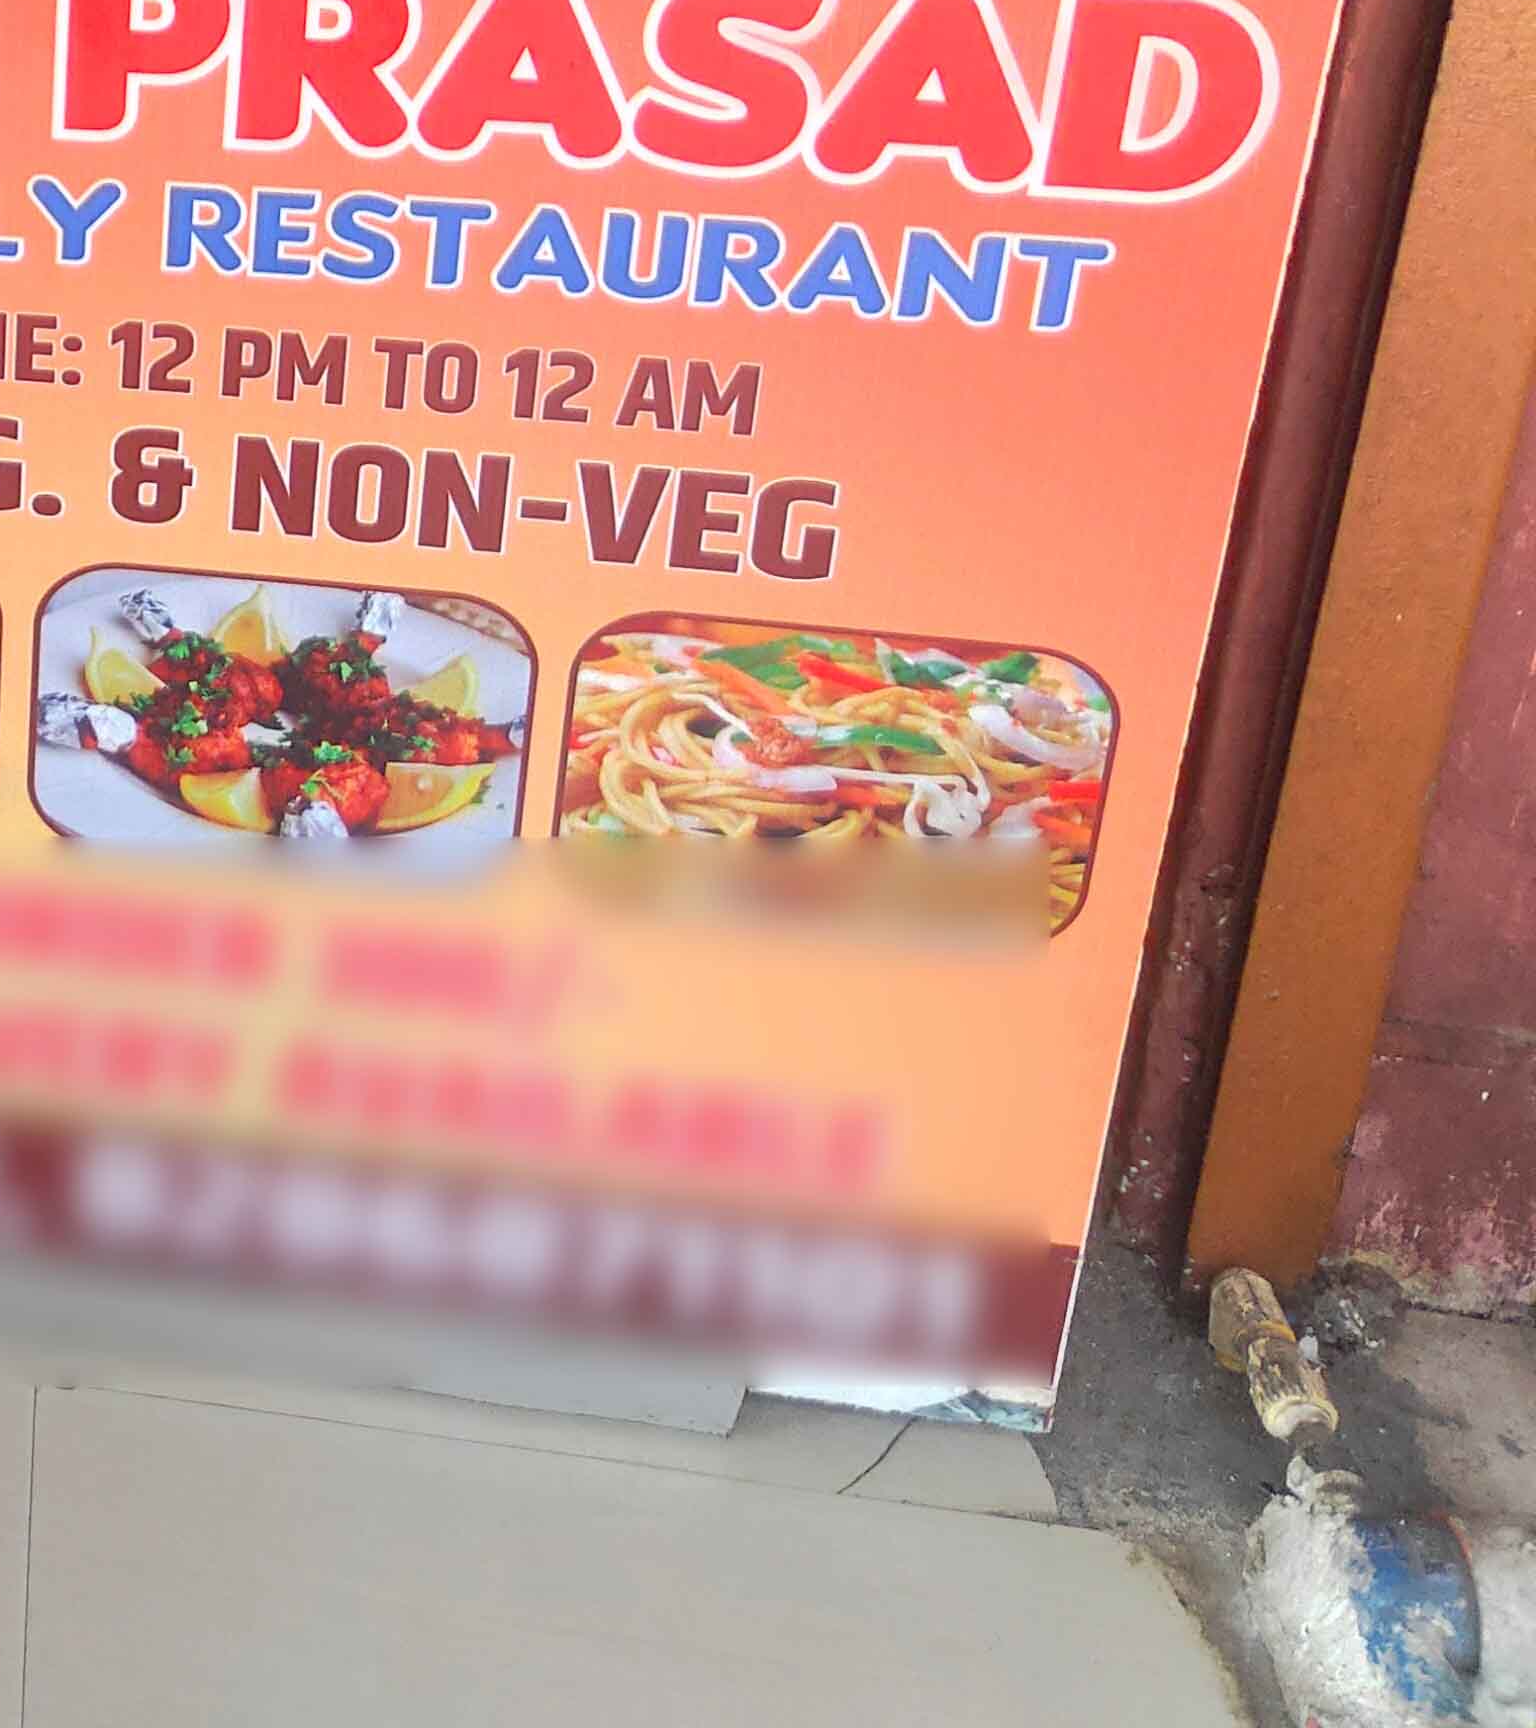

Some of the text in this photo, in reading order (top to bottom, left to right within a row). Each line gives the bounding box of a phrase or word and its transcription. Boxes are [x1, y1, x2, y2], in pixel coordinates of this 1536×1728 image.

[160, 183, 1116, 332] RESTAURANT
[109, 319, 195, 395] 12
[220, 325, 349, 407] PM
[373, 336, 480, 416] TO
[504, 348, 595, 425] 12
[614, 355, 762, 436] AM
[108, 425, 194, 530] &
[230, 432, 842, 583] NON-VEG
